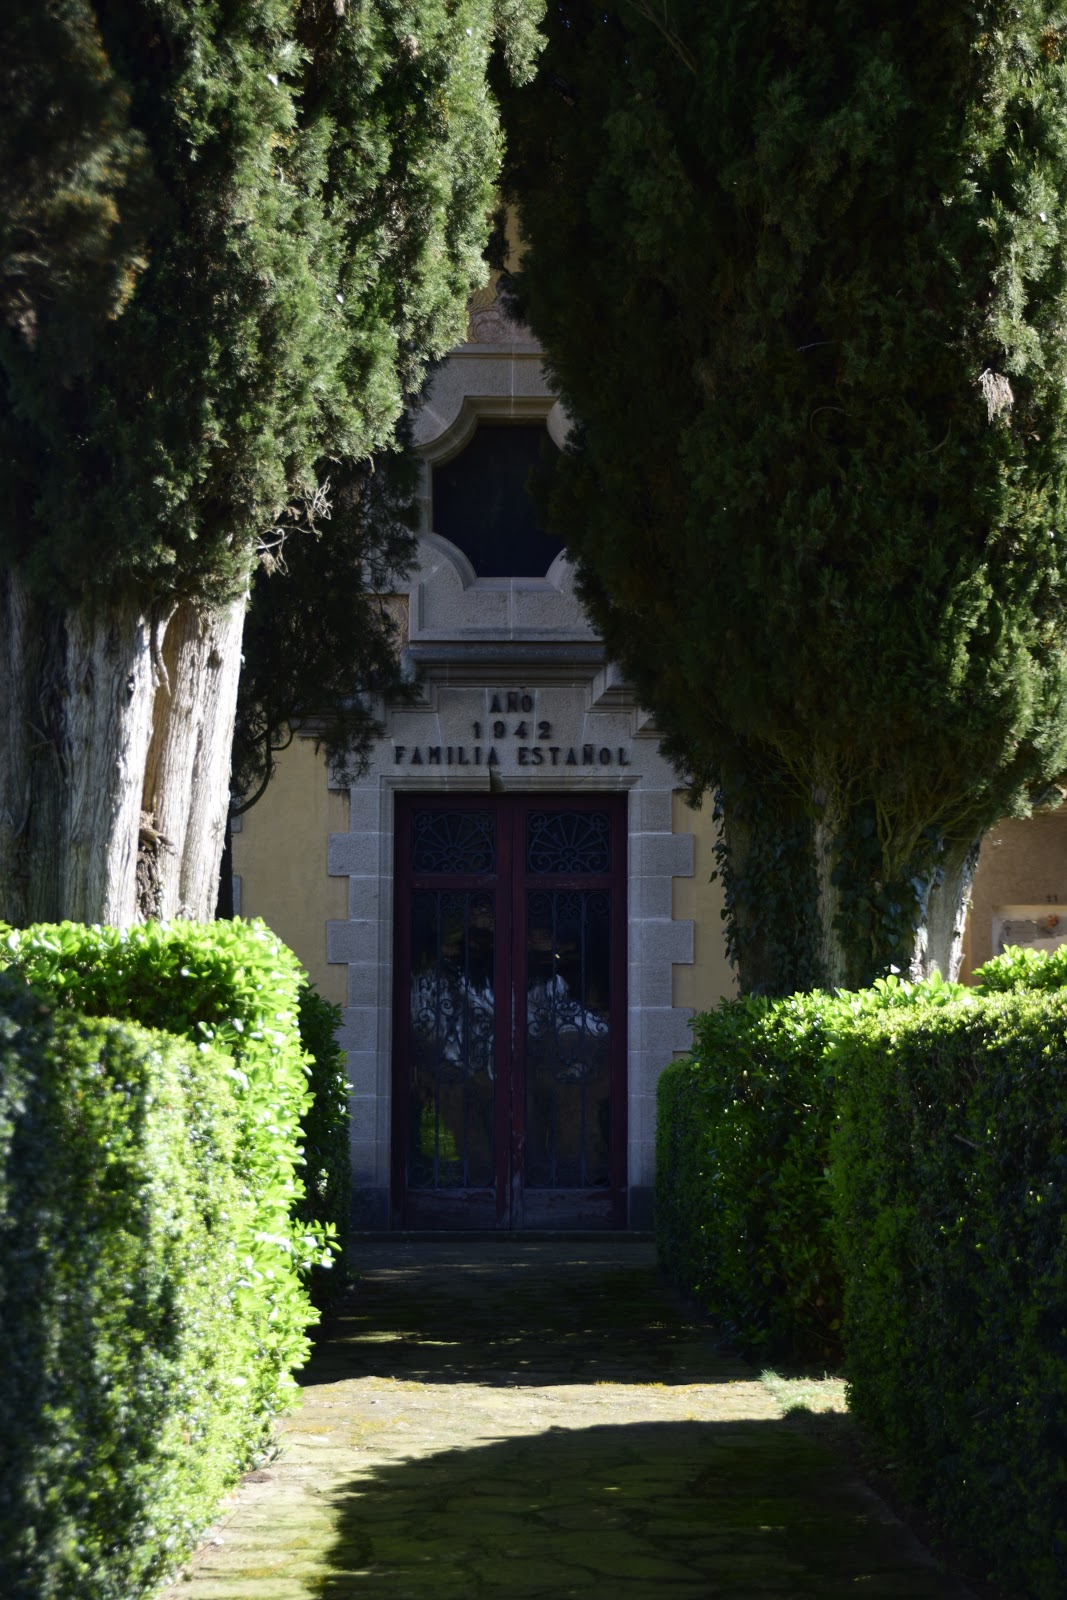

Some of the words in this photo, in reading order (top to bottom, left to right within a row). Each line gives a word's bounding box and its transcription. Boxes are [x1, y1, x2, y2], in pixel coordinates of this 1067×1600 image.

[490, 691, 533, 713] AÑO
[473, 721, 552, 739] 1942
[394, 745, 499, 765] FAMILIA
[518, 744, 629, 766] ESTAÑOL
